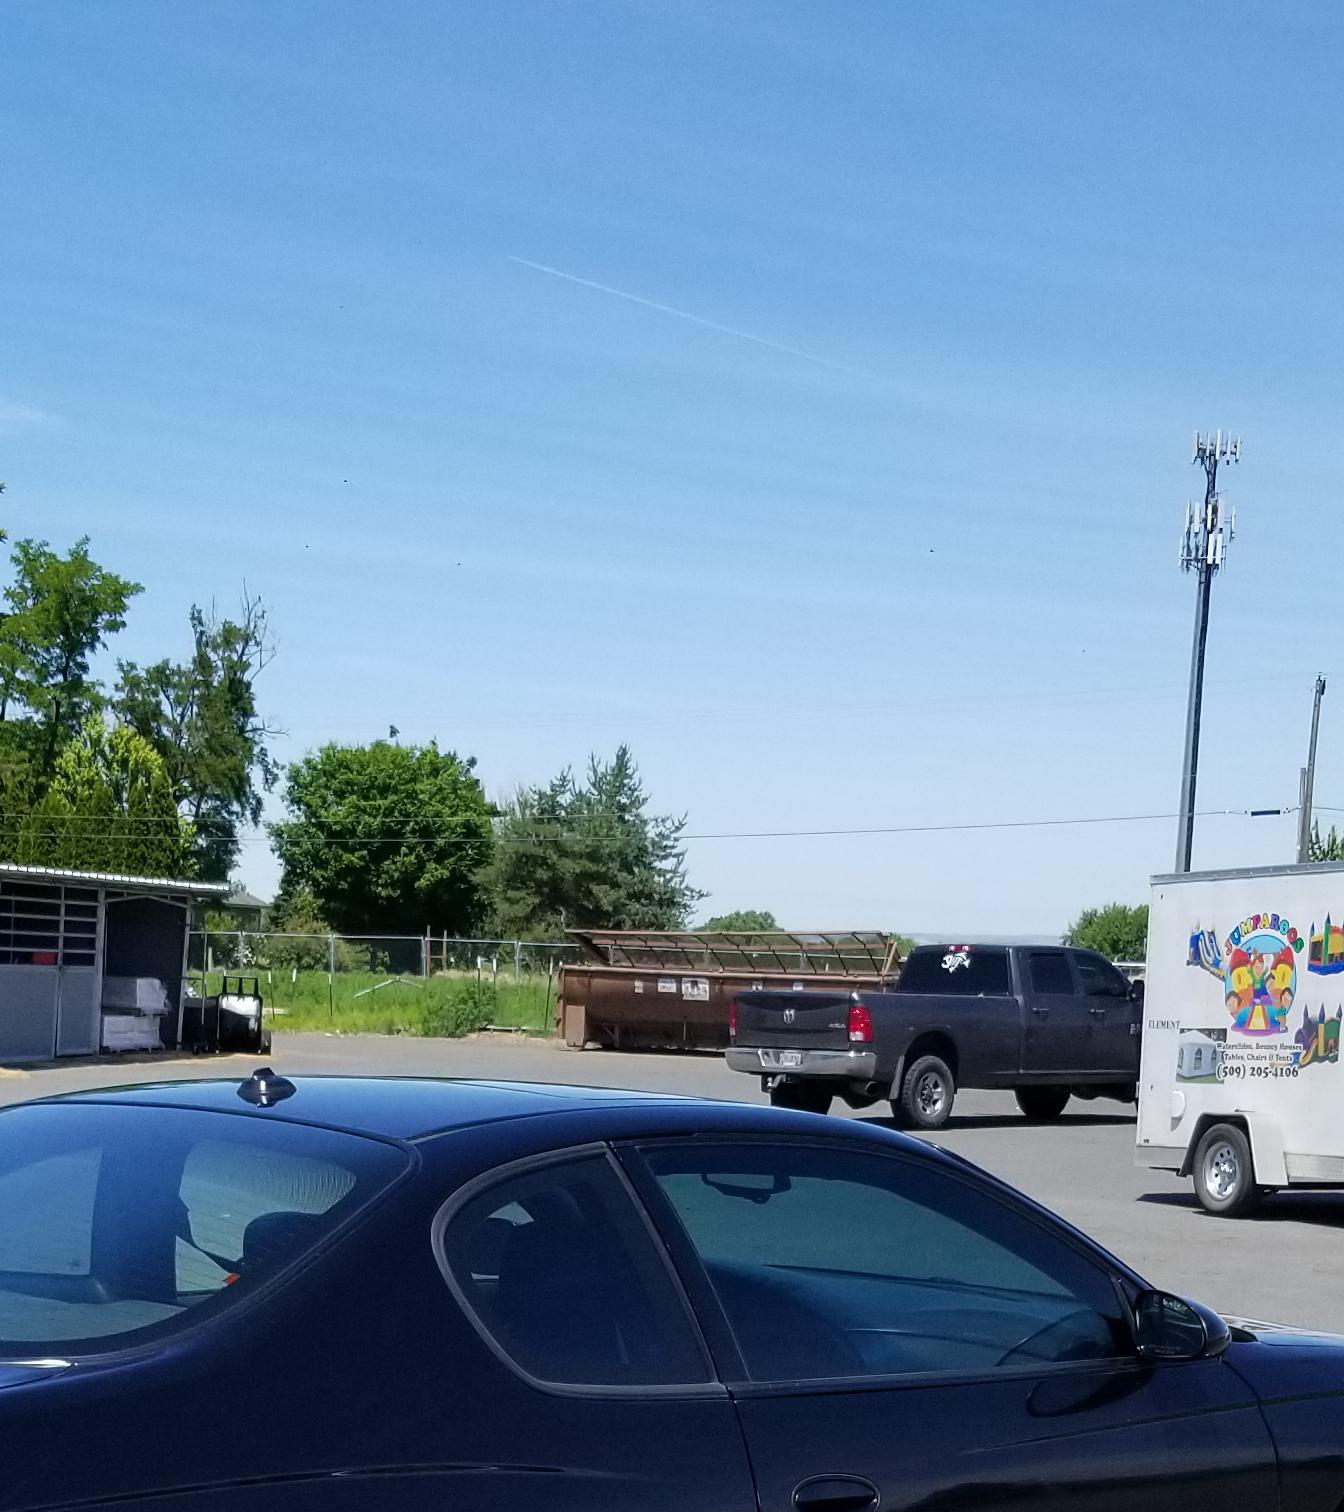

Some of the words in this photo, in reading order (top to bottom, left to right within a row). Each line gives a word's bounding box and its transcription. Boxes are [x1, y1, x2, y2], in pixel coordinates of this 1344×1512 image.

[1224, 912, 1305, 956] JUMPAROOS
[1148, 1019, 1181, 1030] ELEMENT
[1279, 1042, 1302, 1050] Houses
[1224, 1053, 1245, 1061] Tables,
[1246, 1053, 1267, 1061] Chairs
[1275, 1053, 1293, 1062] Tents
[1216, 1063, 1247, 1080] (509)
[1249, 1066, 1299, 1079] 205-4106
